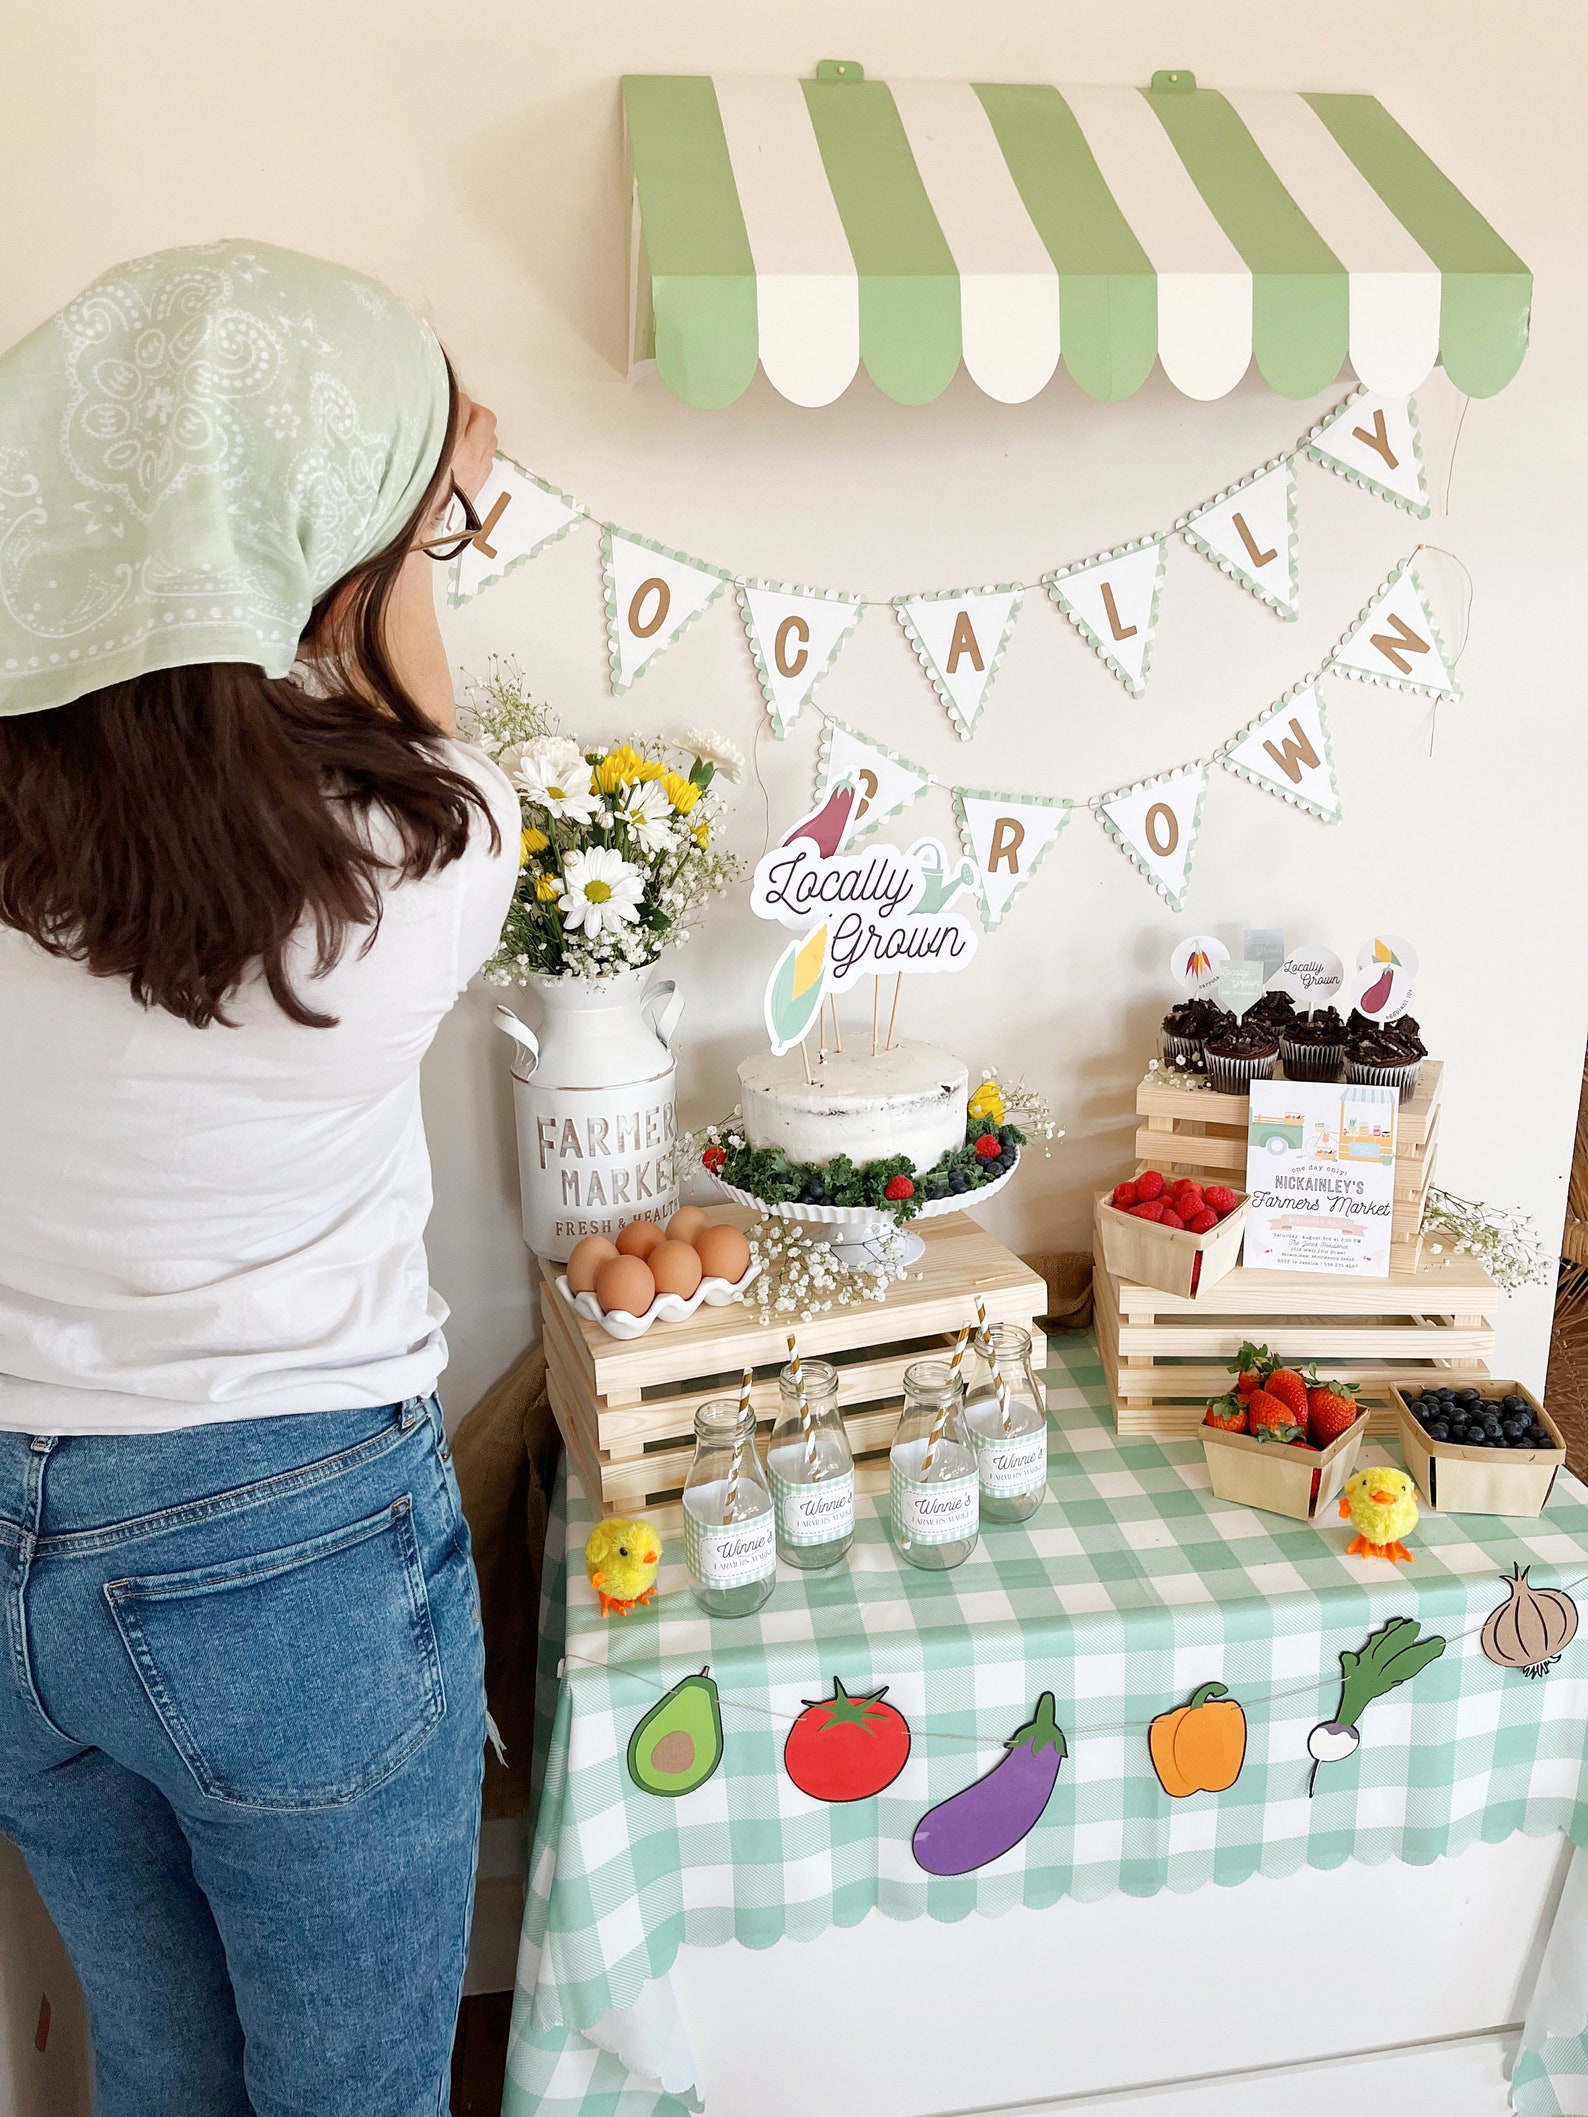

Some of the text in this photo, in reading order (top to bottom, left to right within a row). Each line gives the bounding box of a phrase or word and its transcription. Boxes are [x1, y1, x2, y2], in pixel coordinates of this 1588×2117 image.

[766, 852, 914, 918] Locally
[829, 913, 966, 979] Grown
[1283, 960, 1324, 975] Locally
[1198, 975, 1220, 990] carrots
[1300, 973, 1341, 989] Grown
[1385, 999, 1409, 1020] eggplant
[1291, 1165, 1305, 1173] one
[1309, 1164, 1323, 1172] day
[1275, 1174, 1364, 1194] NICKAINLEY'S
[1252, 1190, 1390, 1217] Farmers Market
[556, 1218, 612, 1237] FRESH
[618, 1217, 626, 1230] &
[993, 1445, 1043, 1470] Winnie's
[800, 1489, 853, 1517] Winnie's
[915, 1491, 971, 1515] Winnie's
[716, 1528, 773, 1558] Winnie's
